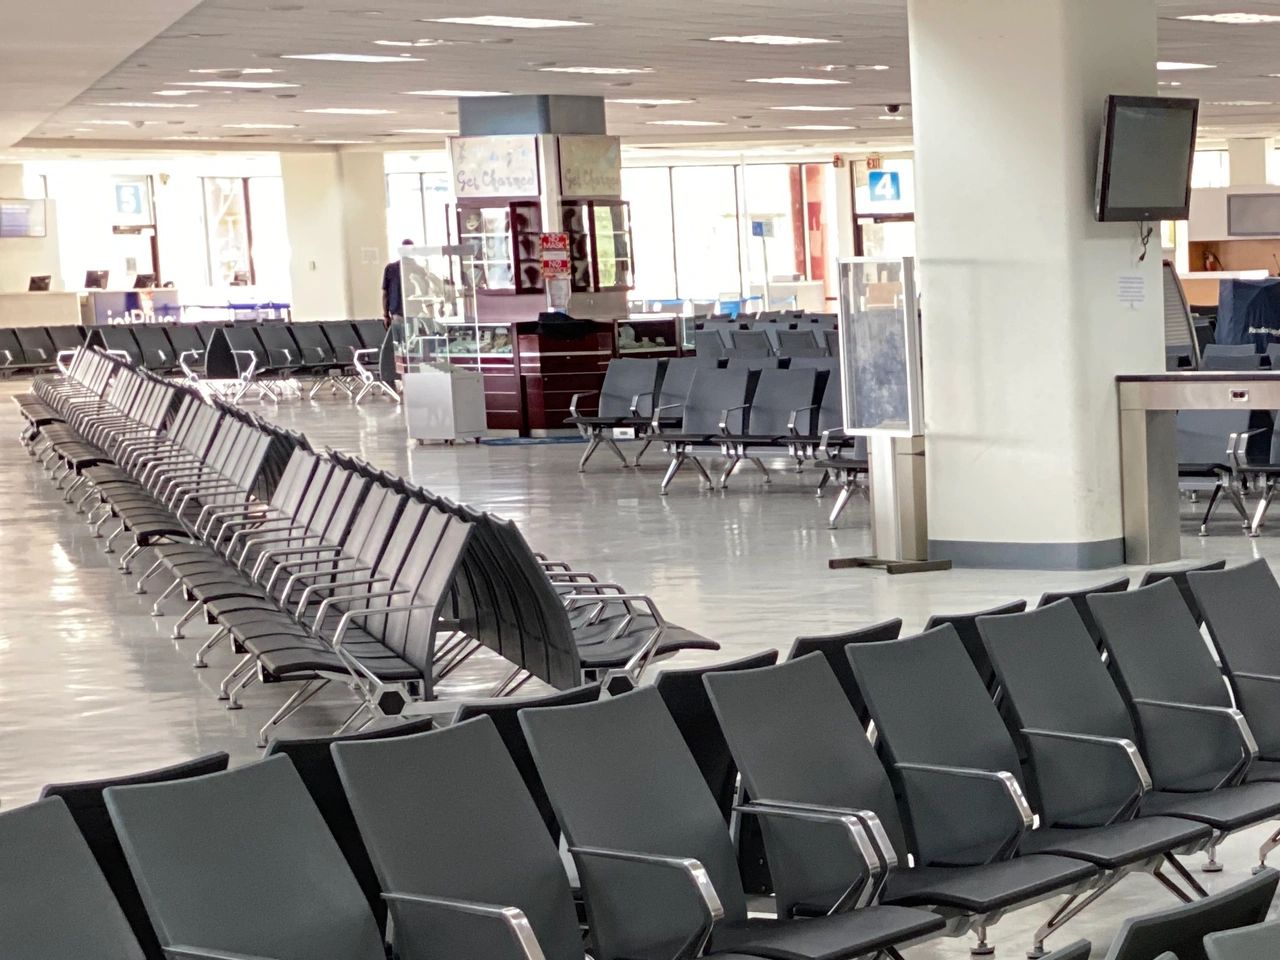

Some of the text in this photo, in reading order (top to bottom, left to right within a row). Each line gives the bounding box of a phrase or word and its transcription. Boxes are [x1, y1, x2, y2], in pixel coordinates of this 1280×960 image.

[457, 170, 480, 192] Get
[875, 173, 895, 200] 4
[120, 186, 137, 213] 5
[543, 241, 565, 249] MASK
[548, 260, 562, 268] NO
